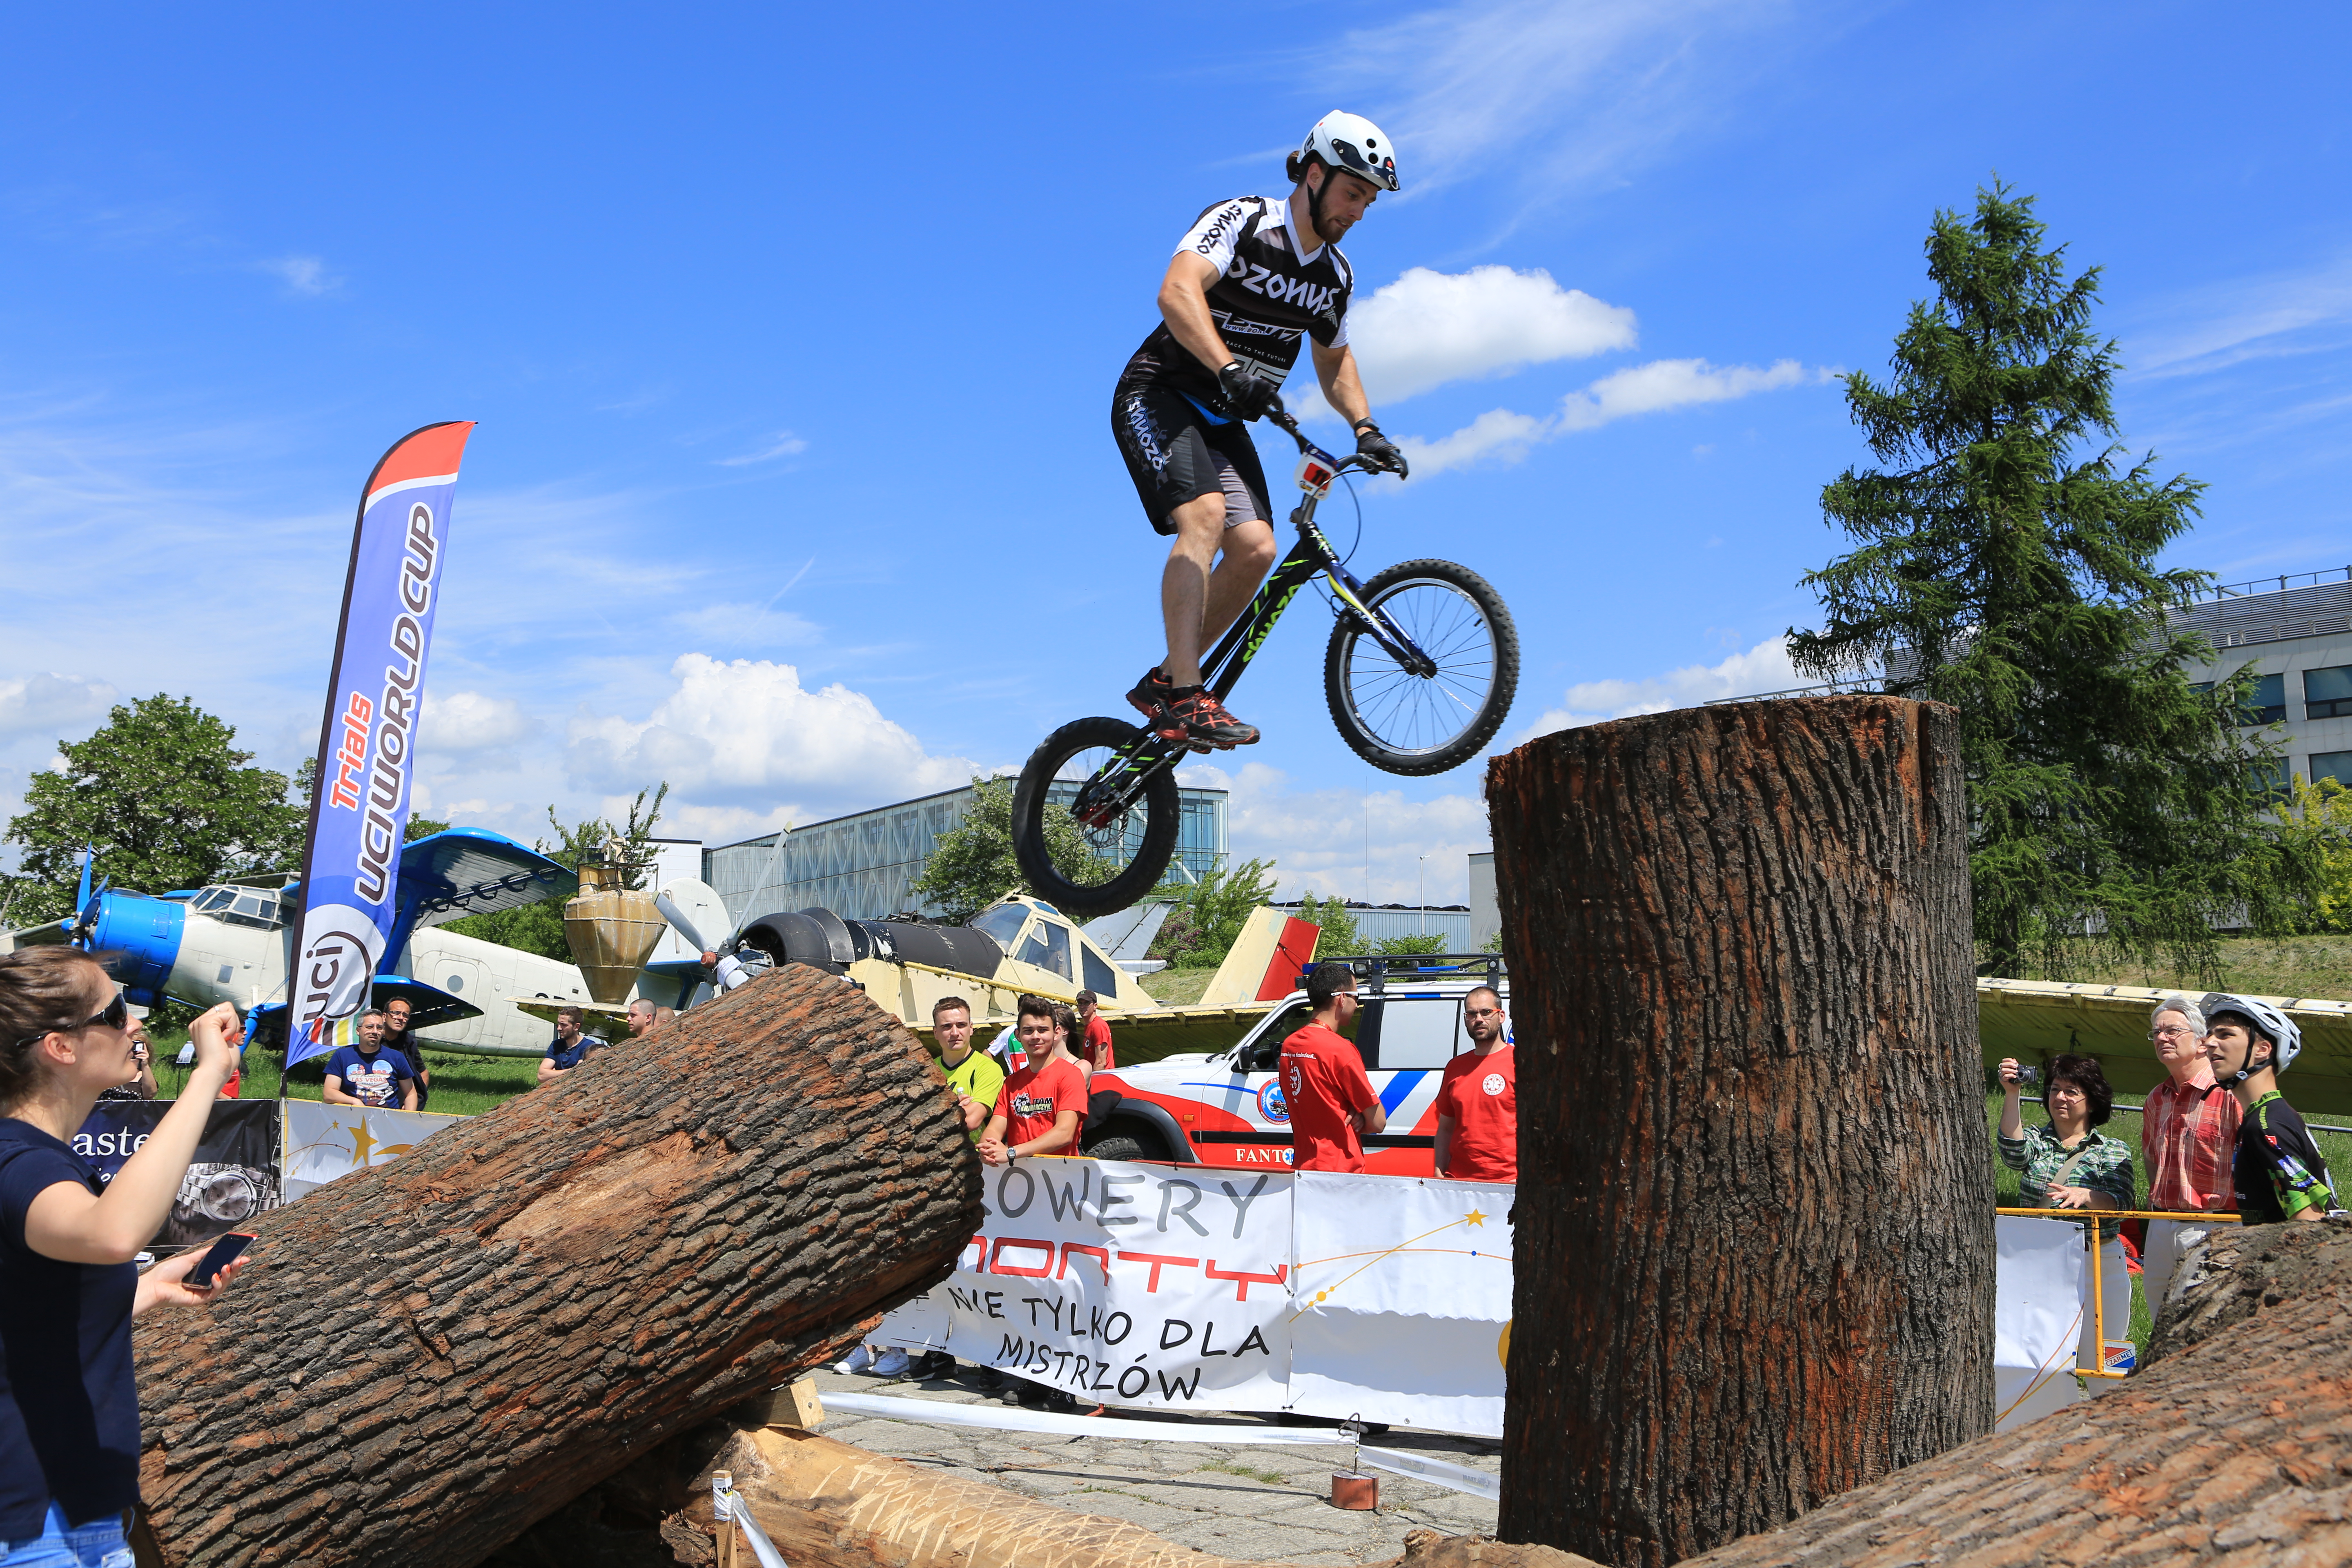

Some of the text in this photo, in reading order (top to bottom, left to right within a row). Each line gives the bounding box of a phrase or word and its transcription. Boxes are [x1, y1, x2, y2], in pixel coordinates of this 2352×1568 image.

[1267, 354, 1286, 362] FUTURE
[332, 693, 371, 809] Trials
[981, 1166, 1267, 1239] OWERY
[947, 1287, 1270, 1358] NIE TYLKO DLA
[996, 1334, 1201, 1401] MISTRZÓW
[2106, 1349, 2133, 1366] CZARMET
